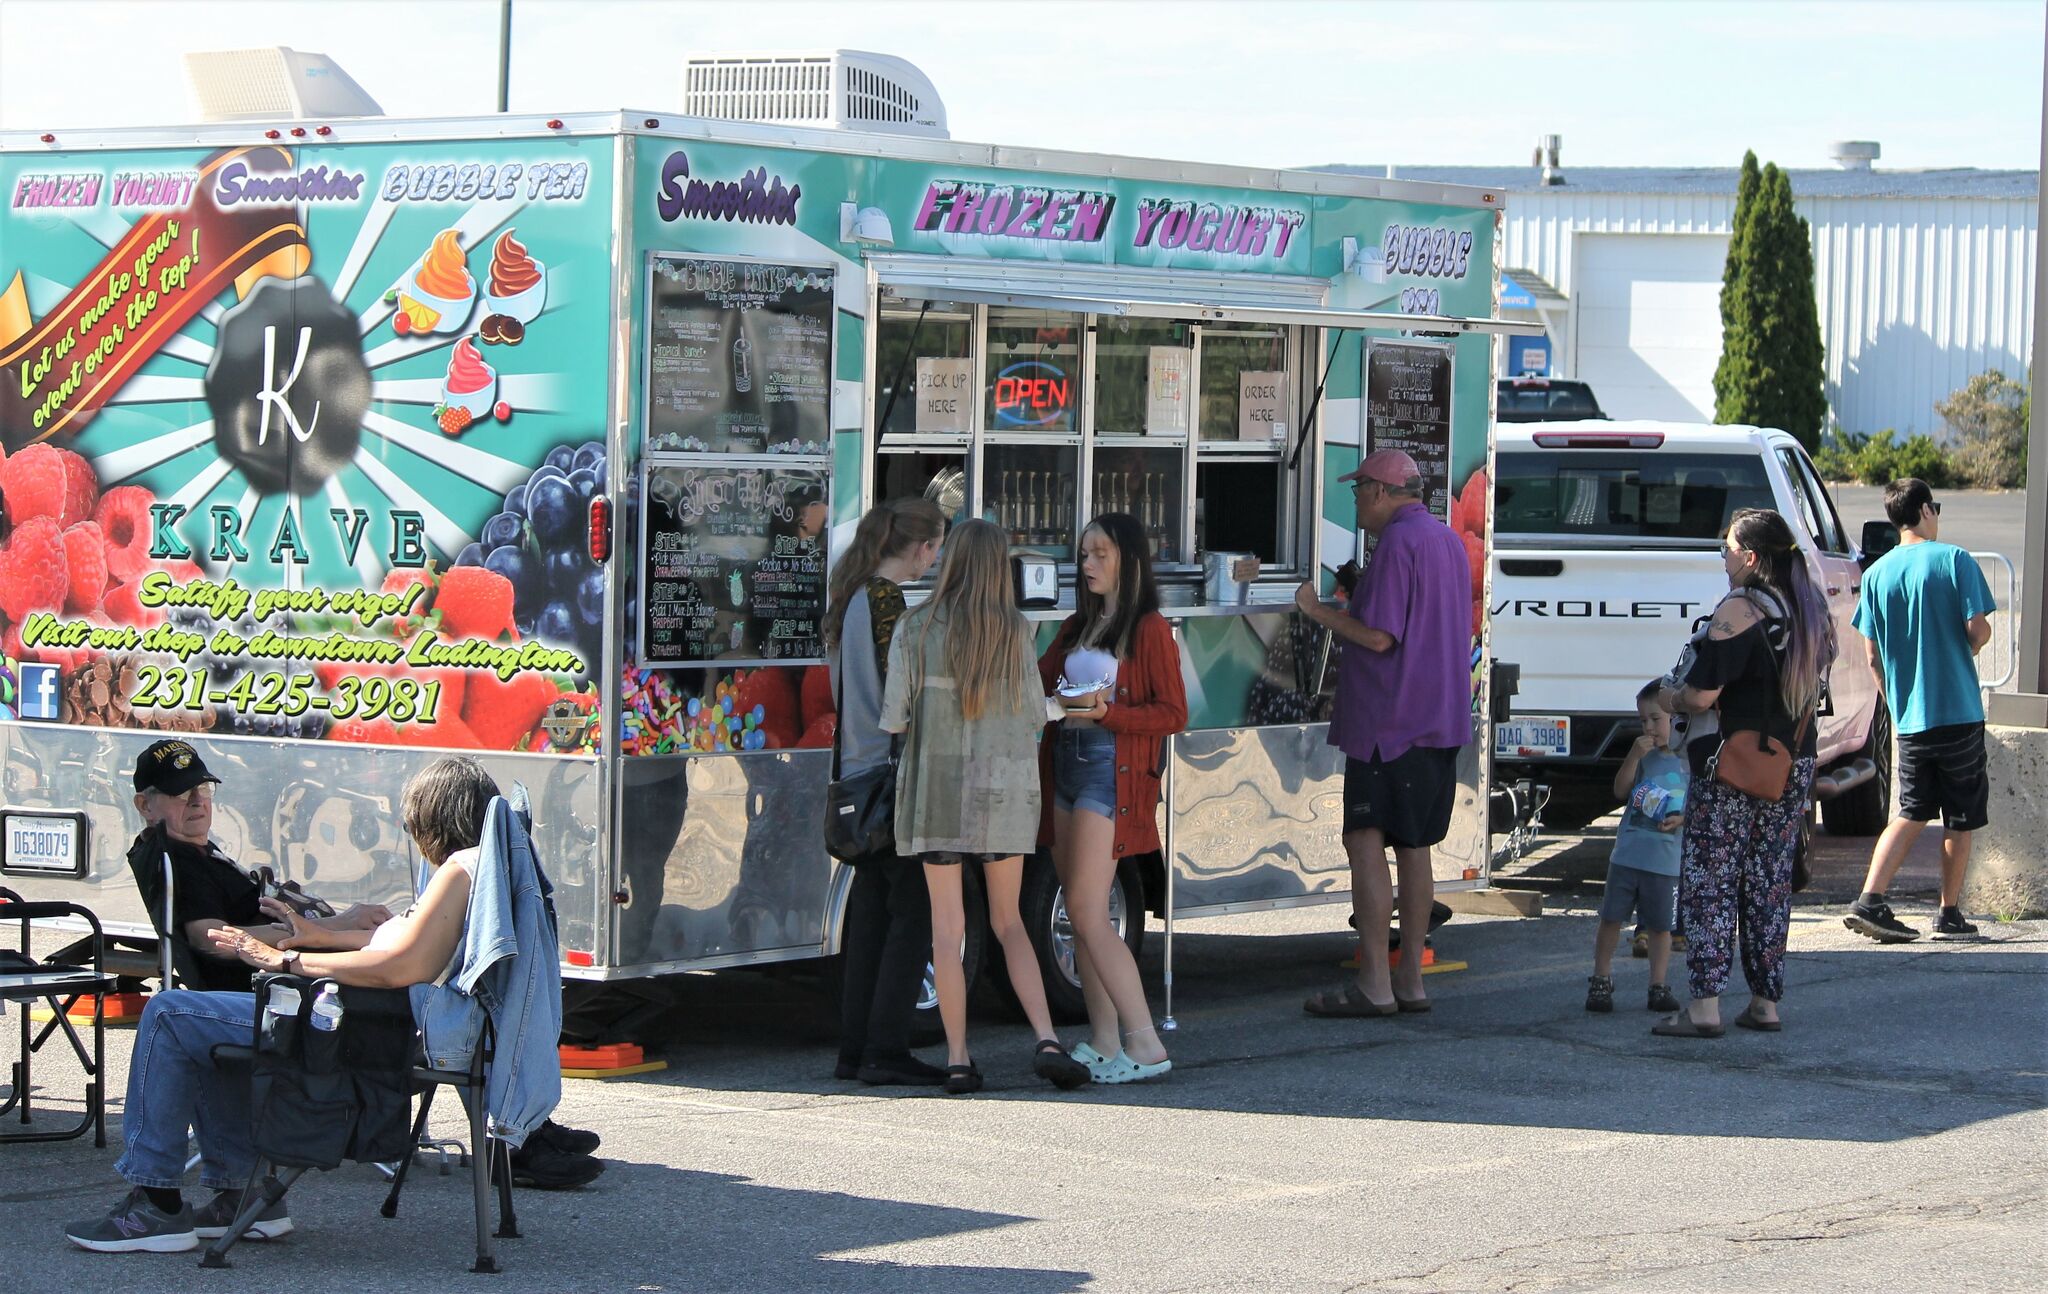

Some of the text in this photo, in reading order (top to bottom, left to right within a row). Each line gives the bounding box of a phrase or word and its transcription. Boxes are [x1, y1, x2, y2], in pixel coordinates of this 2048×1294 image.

[13, 171, 200, 208] FROZEN YOGURT
[215, 162, 364, 206] Smoothies
[382, 161, 588, 201] BUBBLE TEA
[657, 151, 801, 226] Smoothies
[914, 179, 1304, 258] FROZEN YOGURT
[1384, 224, 1472, 279] BUBBLE
[21, 219, 180, 399] Let us make your
[33, 228, 199, 428] event over the top!
[255, 325, 321, 447] K
[919, 373, 968, 389] PICK UP
[994, 378, 1069, 409] OPEN
[1244, 385, 1276, 400] ORDER
[928, 399, 957, 415] HERE
[1249, 408, 1274, 422] HERE
[149, 502, 428, 568] KRAVE
[655, 531, 681, 550] STEP
[775, 534, 799, 554] STEP
[138, 571, 425, 627] Satisfy your urge!
[653, 582, 678, 601] STEP
[772, 619, 797, 636] STEP
[22, 613, 586, 683] Visit our shop in downtown Ludington.
[37, 669, 56, 718] f
[130, 665, 441, 723] 231-425-3981
[1532, 728, 1565, 746] 3988
[14, 831, 69, 857] D638079
